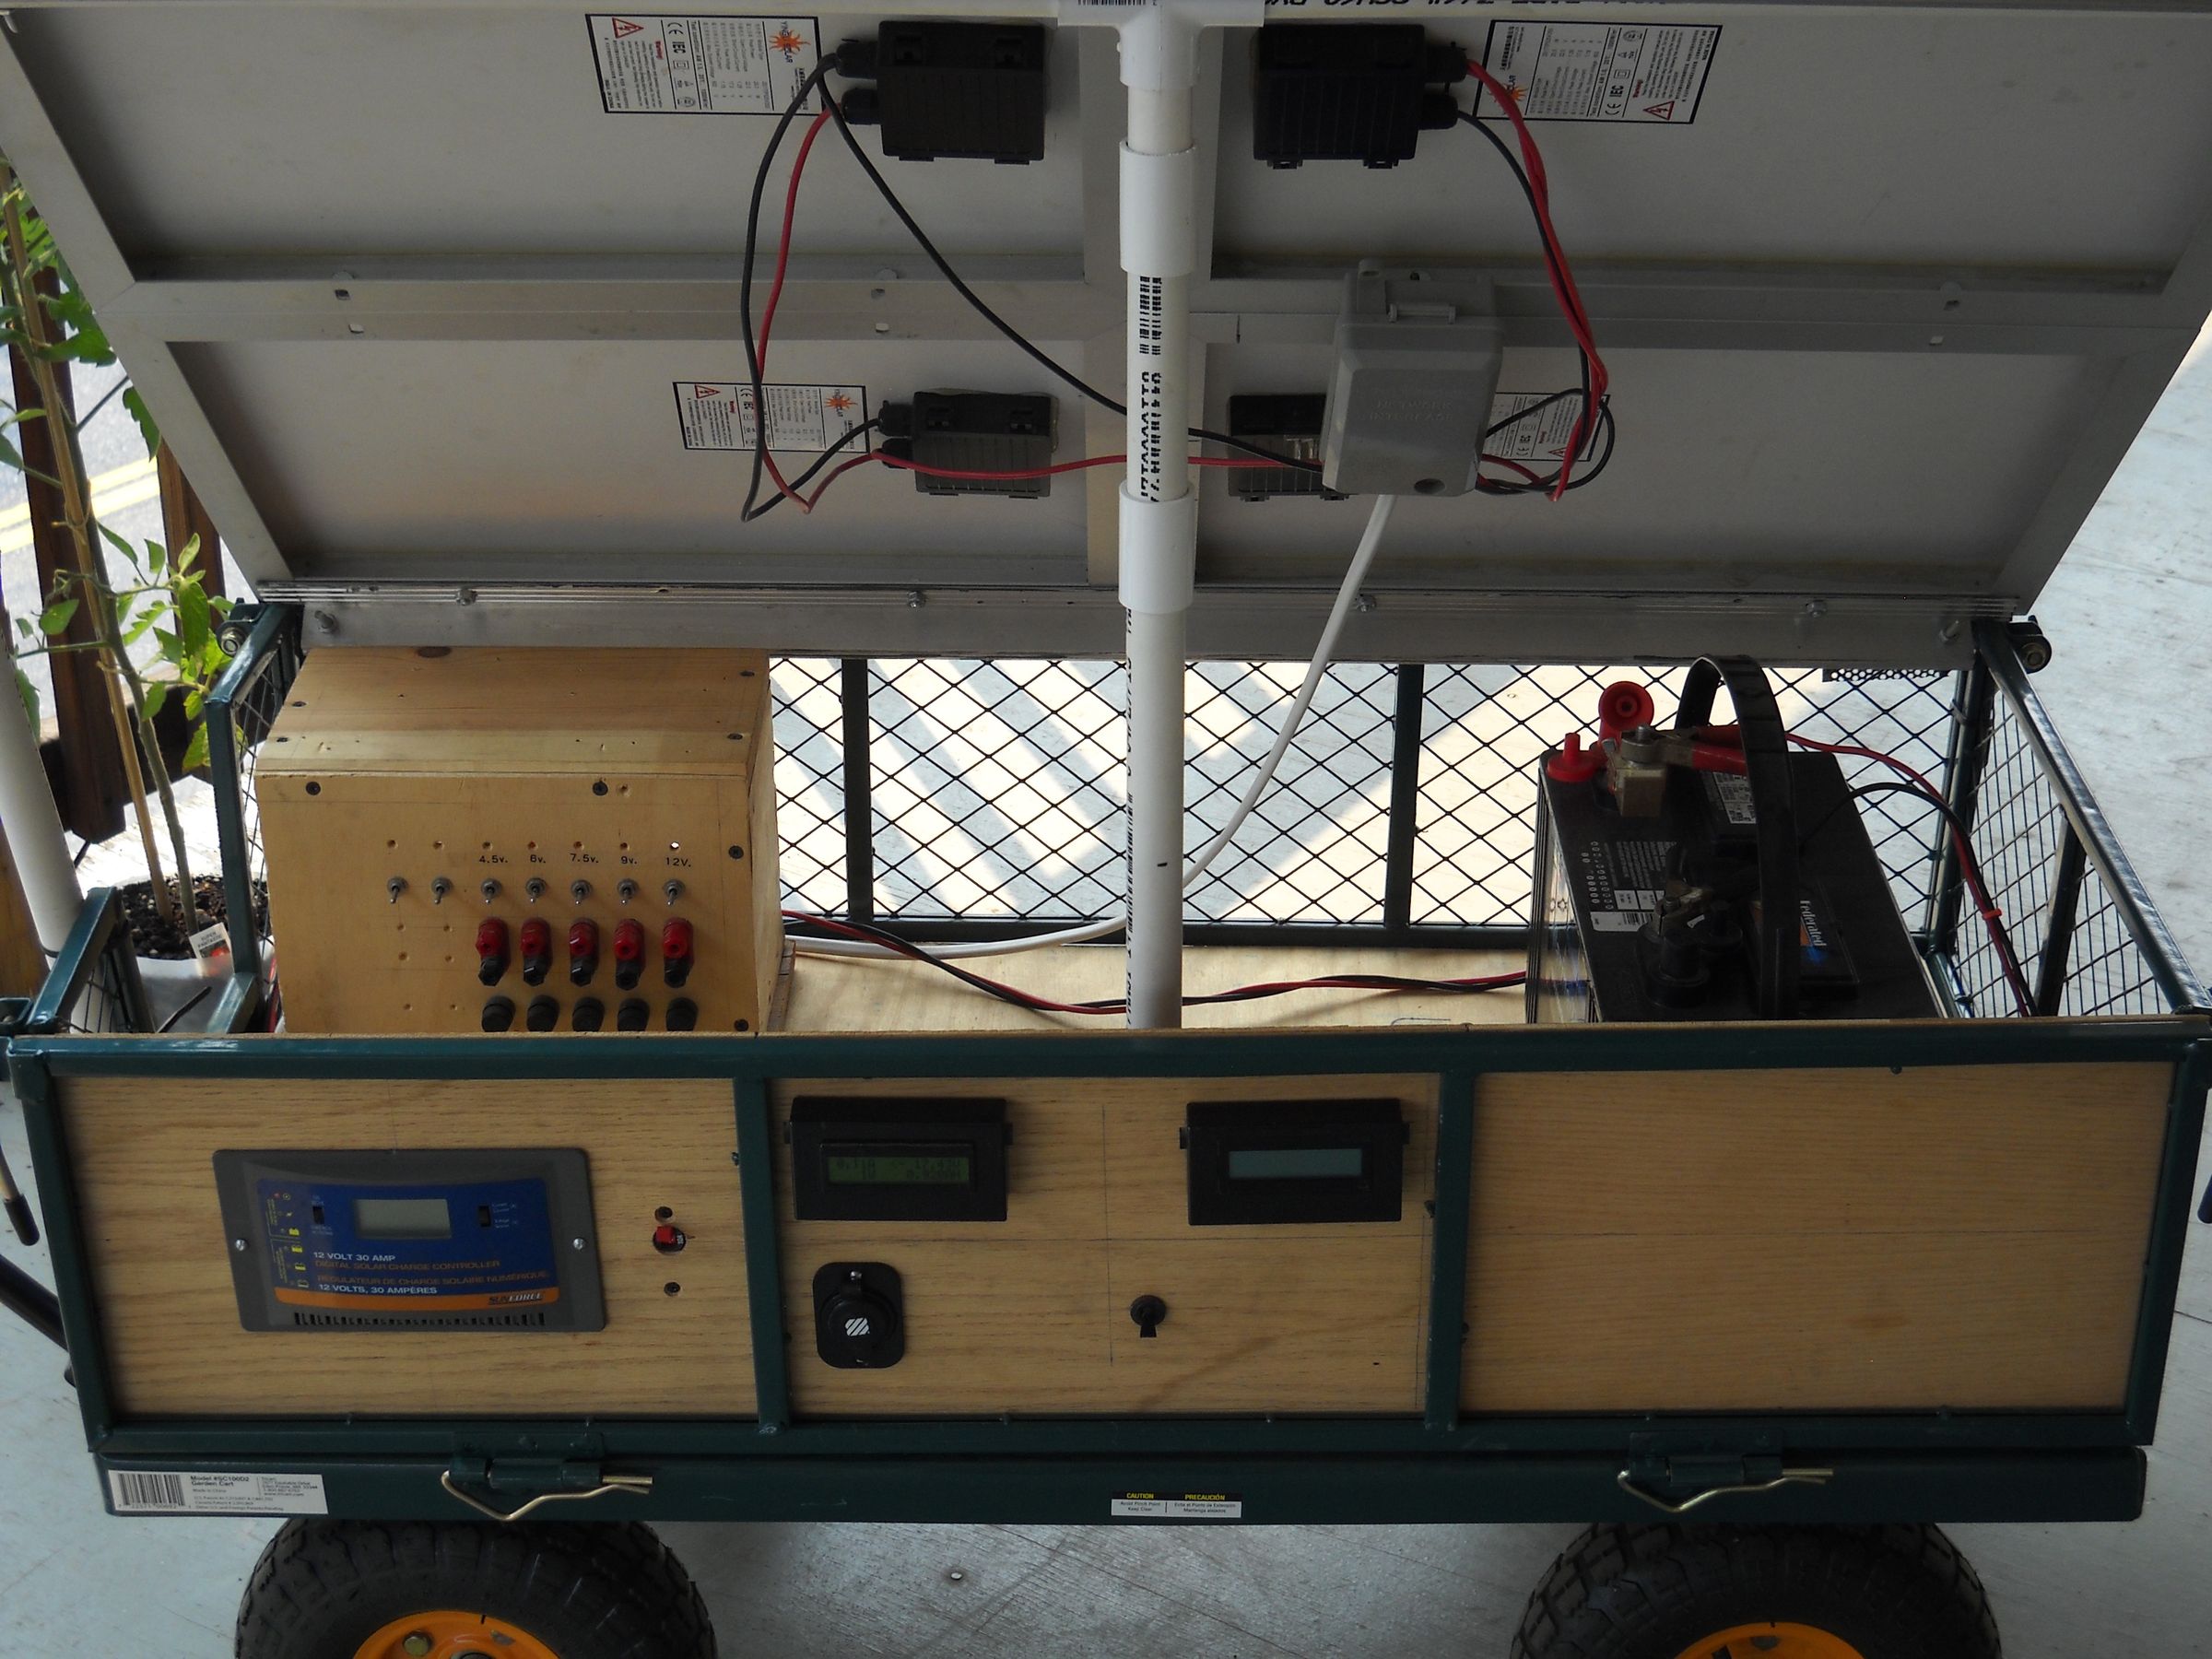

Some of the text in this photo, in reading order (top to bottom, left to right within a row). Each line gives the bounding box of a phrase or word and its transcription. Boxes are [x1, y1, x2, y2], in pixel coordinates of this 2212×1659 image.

[671, 41, 686, 53] IEC
[1608, 85, 1624, 97] IEC
[478, 854, 508, 864] 4.5v.
[571, 853, 599, 864] 7.5v.
[315, 1260, 350, 1268] DIGITAL
[354, 1262, 387, 1270] SOLAR
[432, 1261, 500, 1269] CONTROLLER
[332, 1285, 368, 1293] VOLTS,
